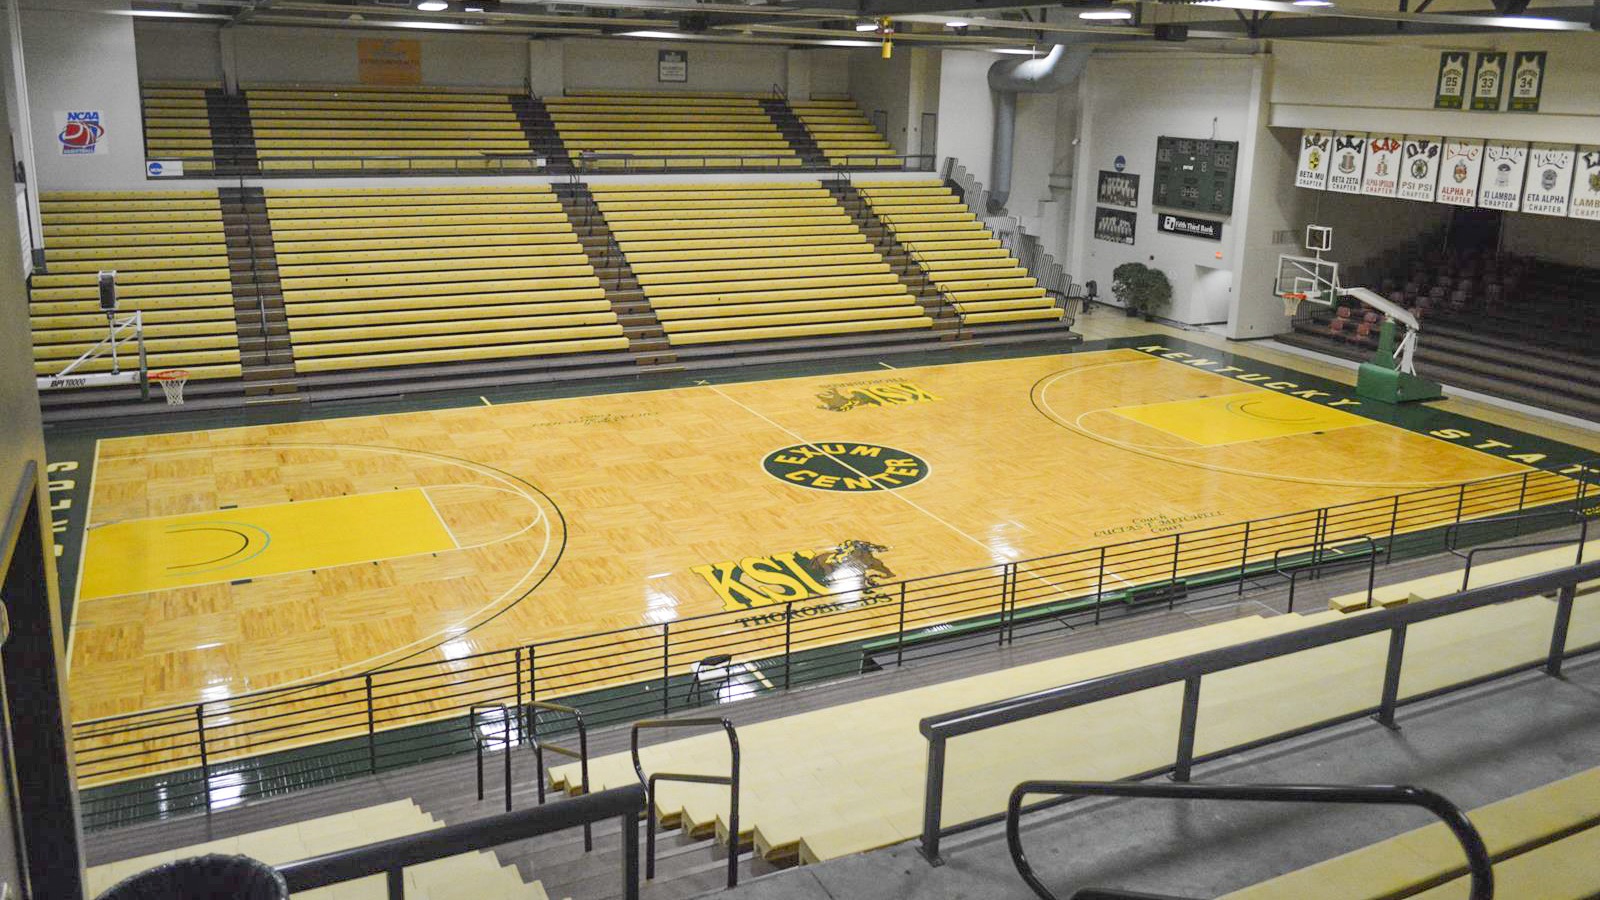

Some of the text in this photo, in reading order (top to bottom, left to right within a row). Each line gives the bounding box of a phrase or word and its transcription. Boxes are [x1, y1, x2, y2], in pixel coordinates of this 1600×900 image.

[1446, 77, 1458, 87] 25
[1482, 78, 1494, 88] 33
[1520, 77, 1533, 88] 34
[67, 111, 99, 120] NCAA
[1299, 170, 1325, 180] BETA MU
[1331, 176, 1345, 184] BETA
[1299, 178, 1322, 187] CHAPTER
[1332, 183, 1357, 191] CHAPTER
[1401, 182, 1415, 190] PSI
[1418, 182, 1432, 191] PSI
[1366, 187, 1393, 195] CHAPTER
[1401, 190, 1430, 199] CHAPTER
[1442, 186, 1474, 197] ALPHA PI
[1484, 190, 1517, 201] XI LAMBDA
[1442, 195, 1471, 204] CHAPTER
[1484, 199, 1514, 208] CHAPTER
[1527, 193, 1565, 204] ETA ALPHA
[1529, 204, 1562, 213] CHAPTER
[1187, 222, 1200, 231] Third
[1201, 224, 1214, 234] Bank
[1136, 345, 1362, 406] KENTUCKY
[773, 444, 882, 465] EXUM
[785, 458, 919, 490] CENTER
